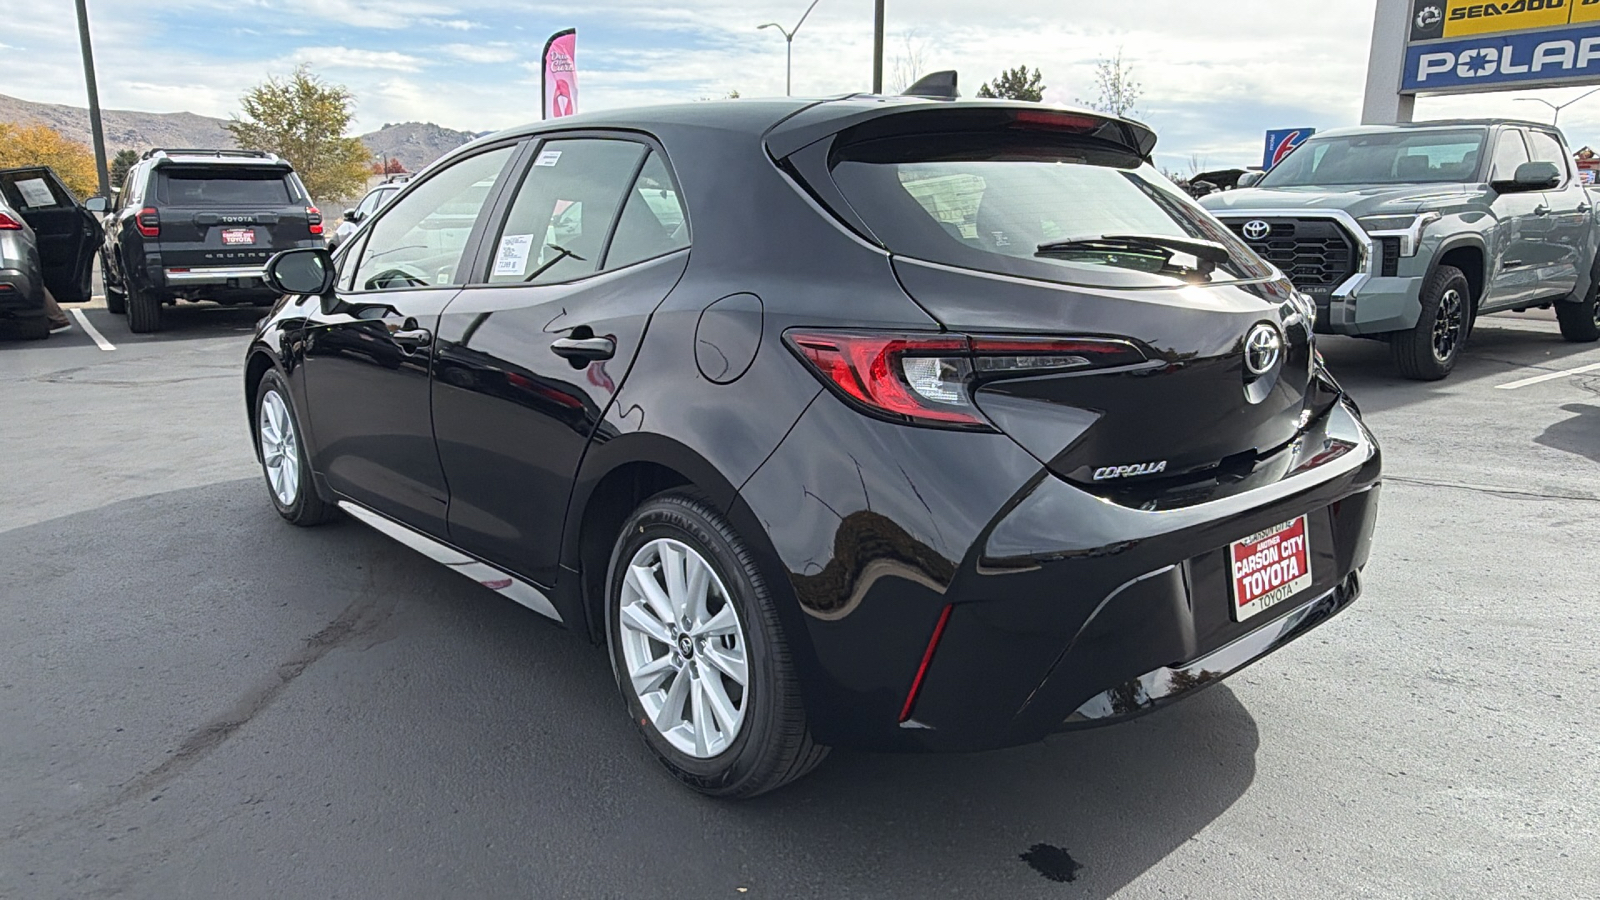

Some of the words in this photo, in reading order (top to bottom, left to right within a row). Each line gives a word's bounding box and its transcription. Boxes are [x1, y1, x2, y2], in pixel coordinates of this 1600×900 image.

[1093, 460, 1167, 480] COROLLA
[662, 511, 720, 553] DUNLOP
[1257, 535, 1280, 552] ANOTHER
[1235, 545, 1278, 578] CARSON
[1281, 535, 1304, 557] CITY
[1242, 556, 1299, 600] TOYOTA
[1258, 585, 1293, 609] TOYOTA
